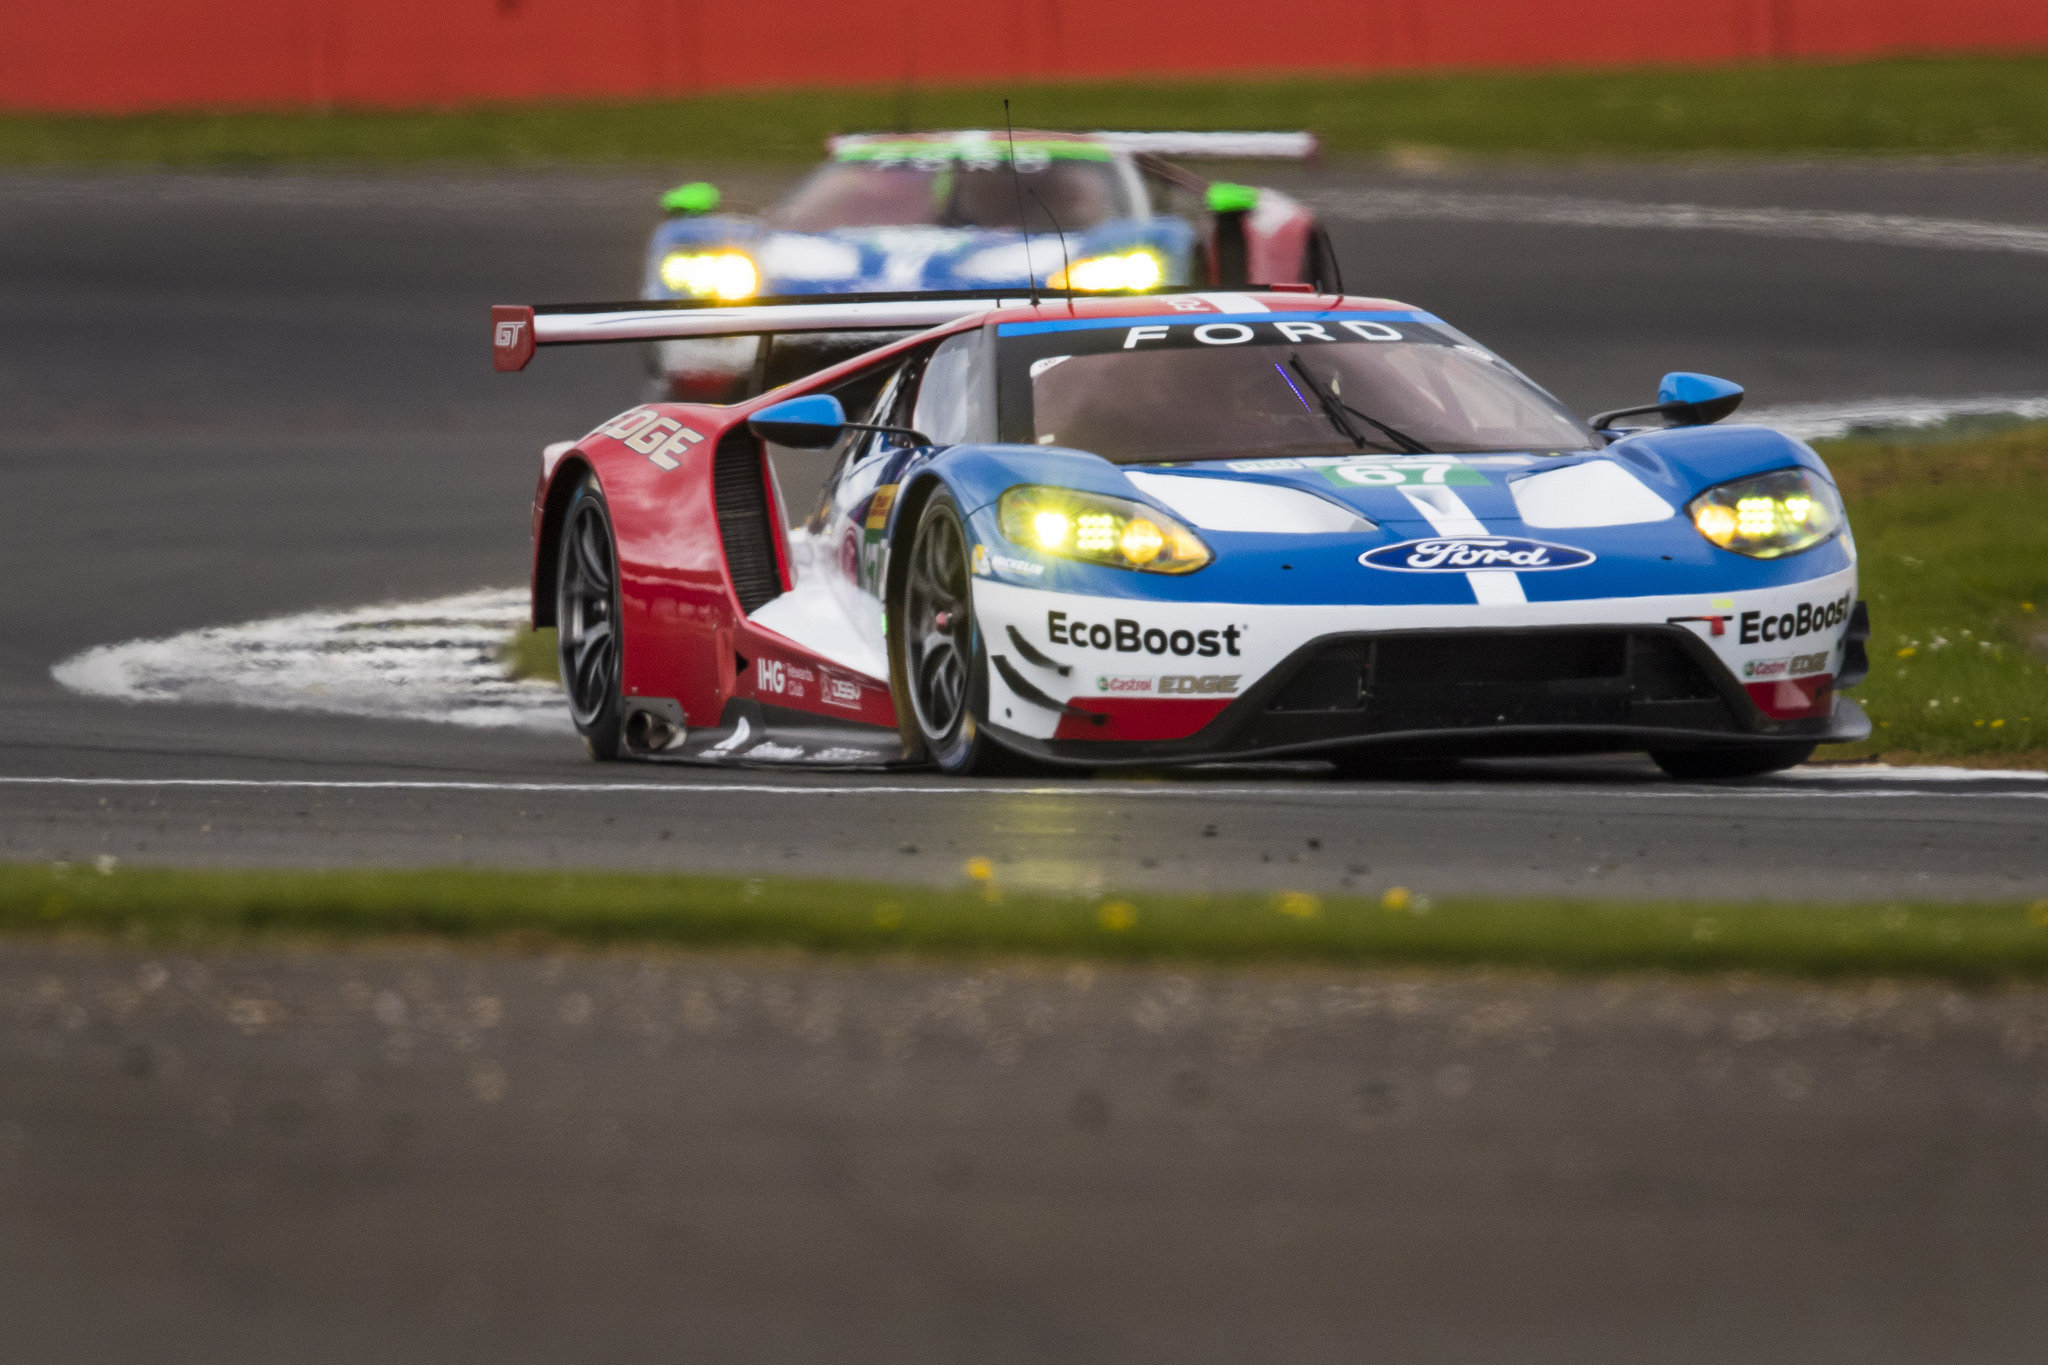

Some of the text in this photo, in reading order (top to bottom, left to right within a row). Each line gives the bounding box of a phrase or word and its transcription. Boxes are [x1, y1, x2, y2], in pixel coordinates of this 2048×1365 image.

[494, 321, 527, 350] GT
[1122, 319, 1404, 350] FORD
[1336, 463, 1452, 485] 67
[1406, 539, 1551, 569] Ford
[1048, 610, 1241, 658] EcoBoost
[757, 658, 785, 694] IHG
[1109, 674, 1242, 694] Castrol EDGE
